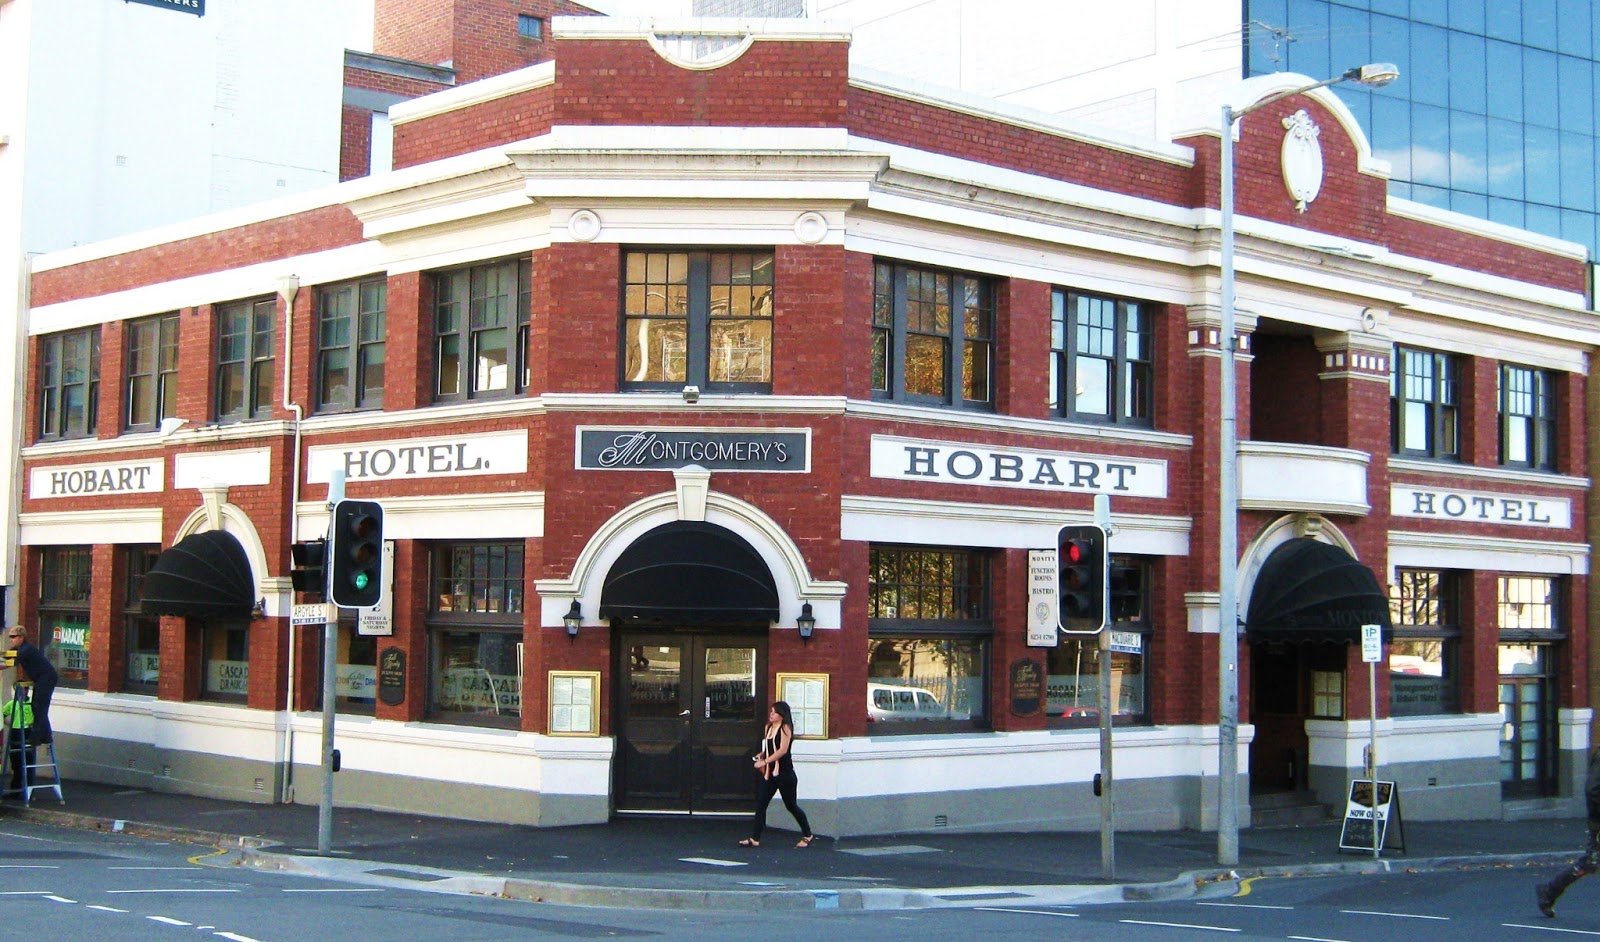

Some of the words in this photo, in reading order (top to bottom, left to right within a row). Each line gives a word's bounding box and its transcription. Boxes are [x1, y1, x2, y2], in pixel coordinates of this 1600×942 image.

[598, 431, 788, 467] MONTGOMERY'S
[903, 446, 1136, 490] HOBART
[50, 466, 151, 495] HOBART
[1412, 492, 1551, 523] HOTEL
[294, 605, 315, 618] ARGYLE
[61, 626, 85, 646] KARAOKE
[1365, 627, 1377, 637] 1P
[1350, 809, 1366, 818] NOW
